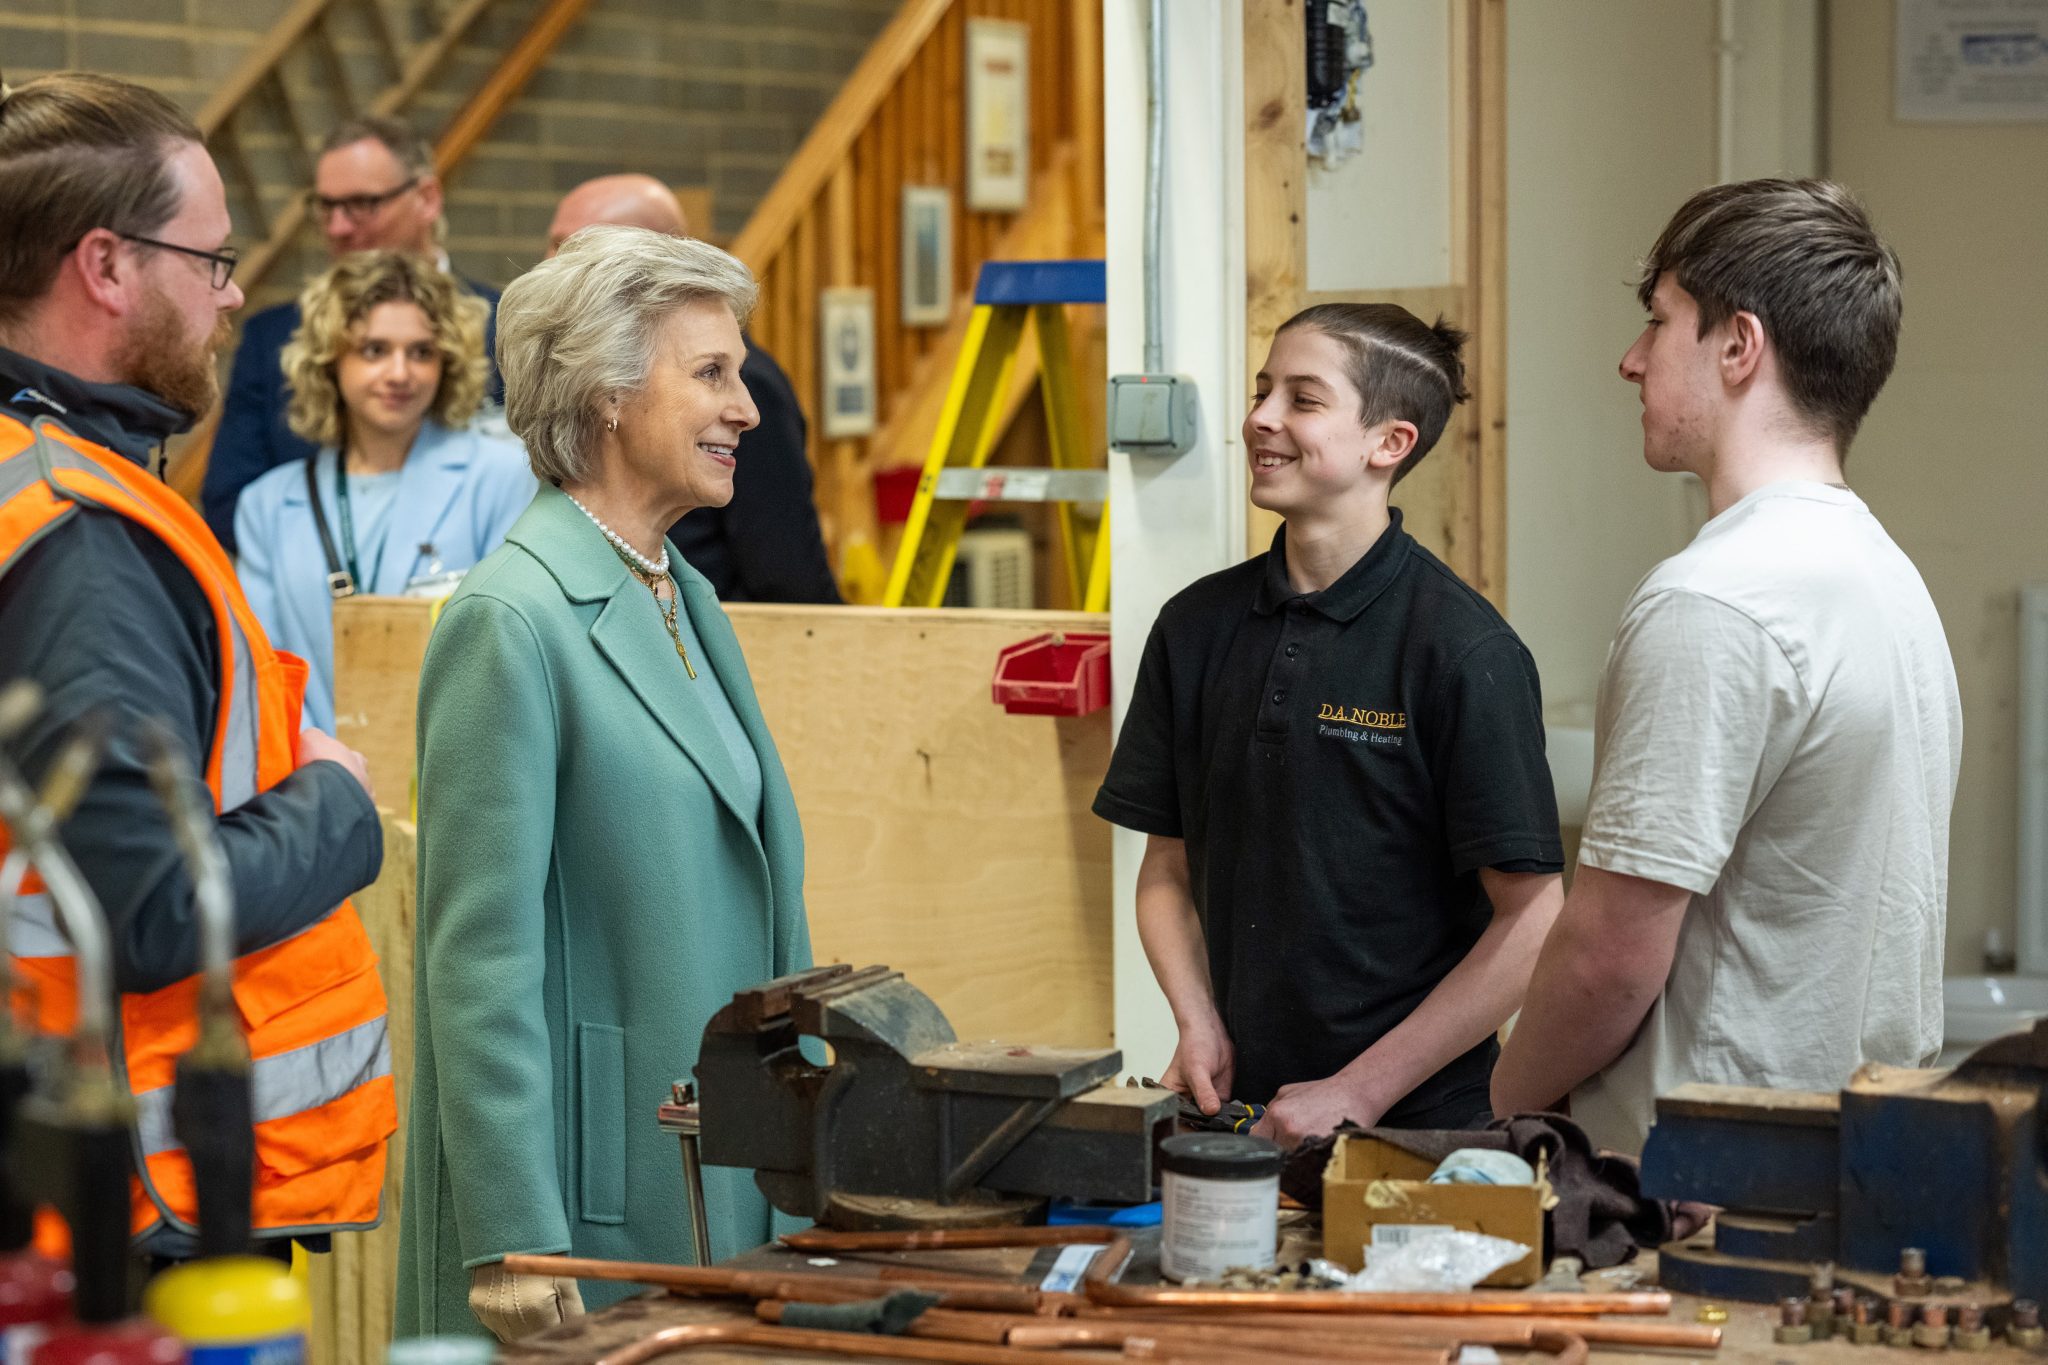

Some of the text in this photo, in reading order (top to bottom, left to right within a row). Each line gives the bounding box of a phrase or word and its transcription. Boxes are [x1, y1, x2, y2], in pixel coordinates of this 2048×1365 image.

[1351, 708, 1407, 727] NOBLE
[1319, 724, 1402, 746] Plumbing & Heating
